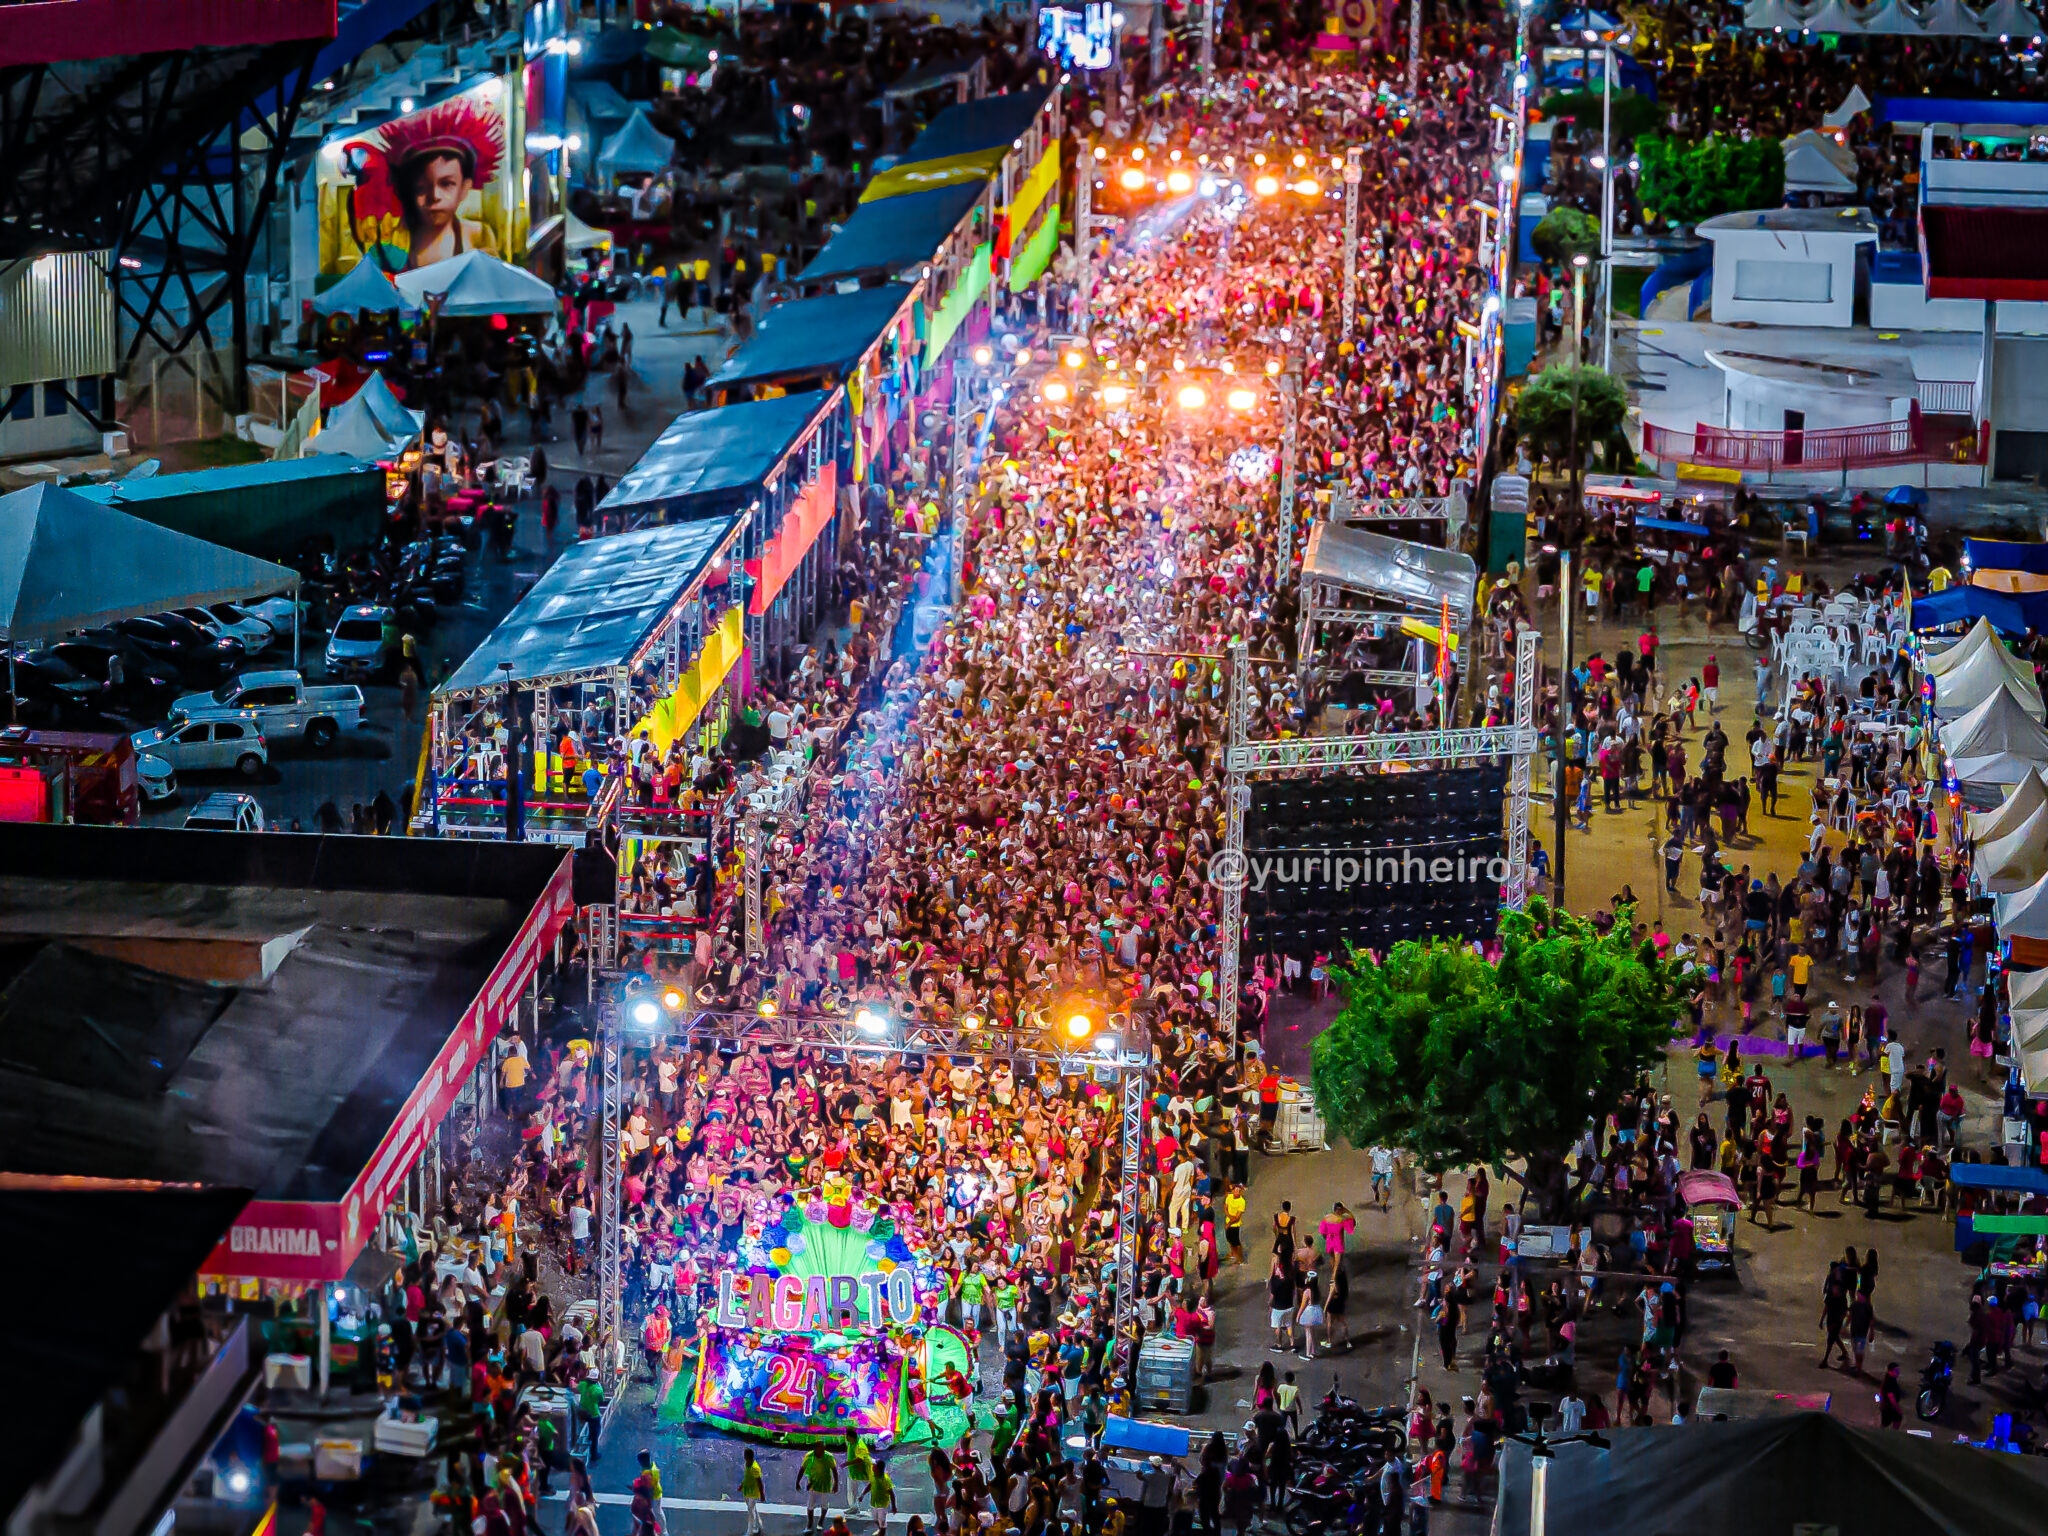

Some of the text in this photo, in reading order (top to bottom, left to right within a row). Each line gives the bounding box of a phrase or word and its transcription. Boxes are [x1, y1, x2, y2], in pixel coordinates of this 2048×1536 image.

[230, 1226, 321, 1256] BRAHMA
[717, 1267, 915, 1331] LAGARTO
[759, 1354, 817, 1417] 24
